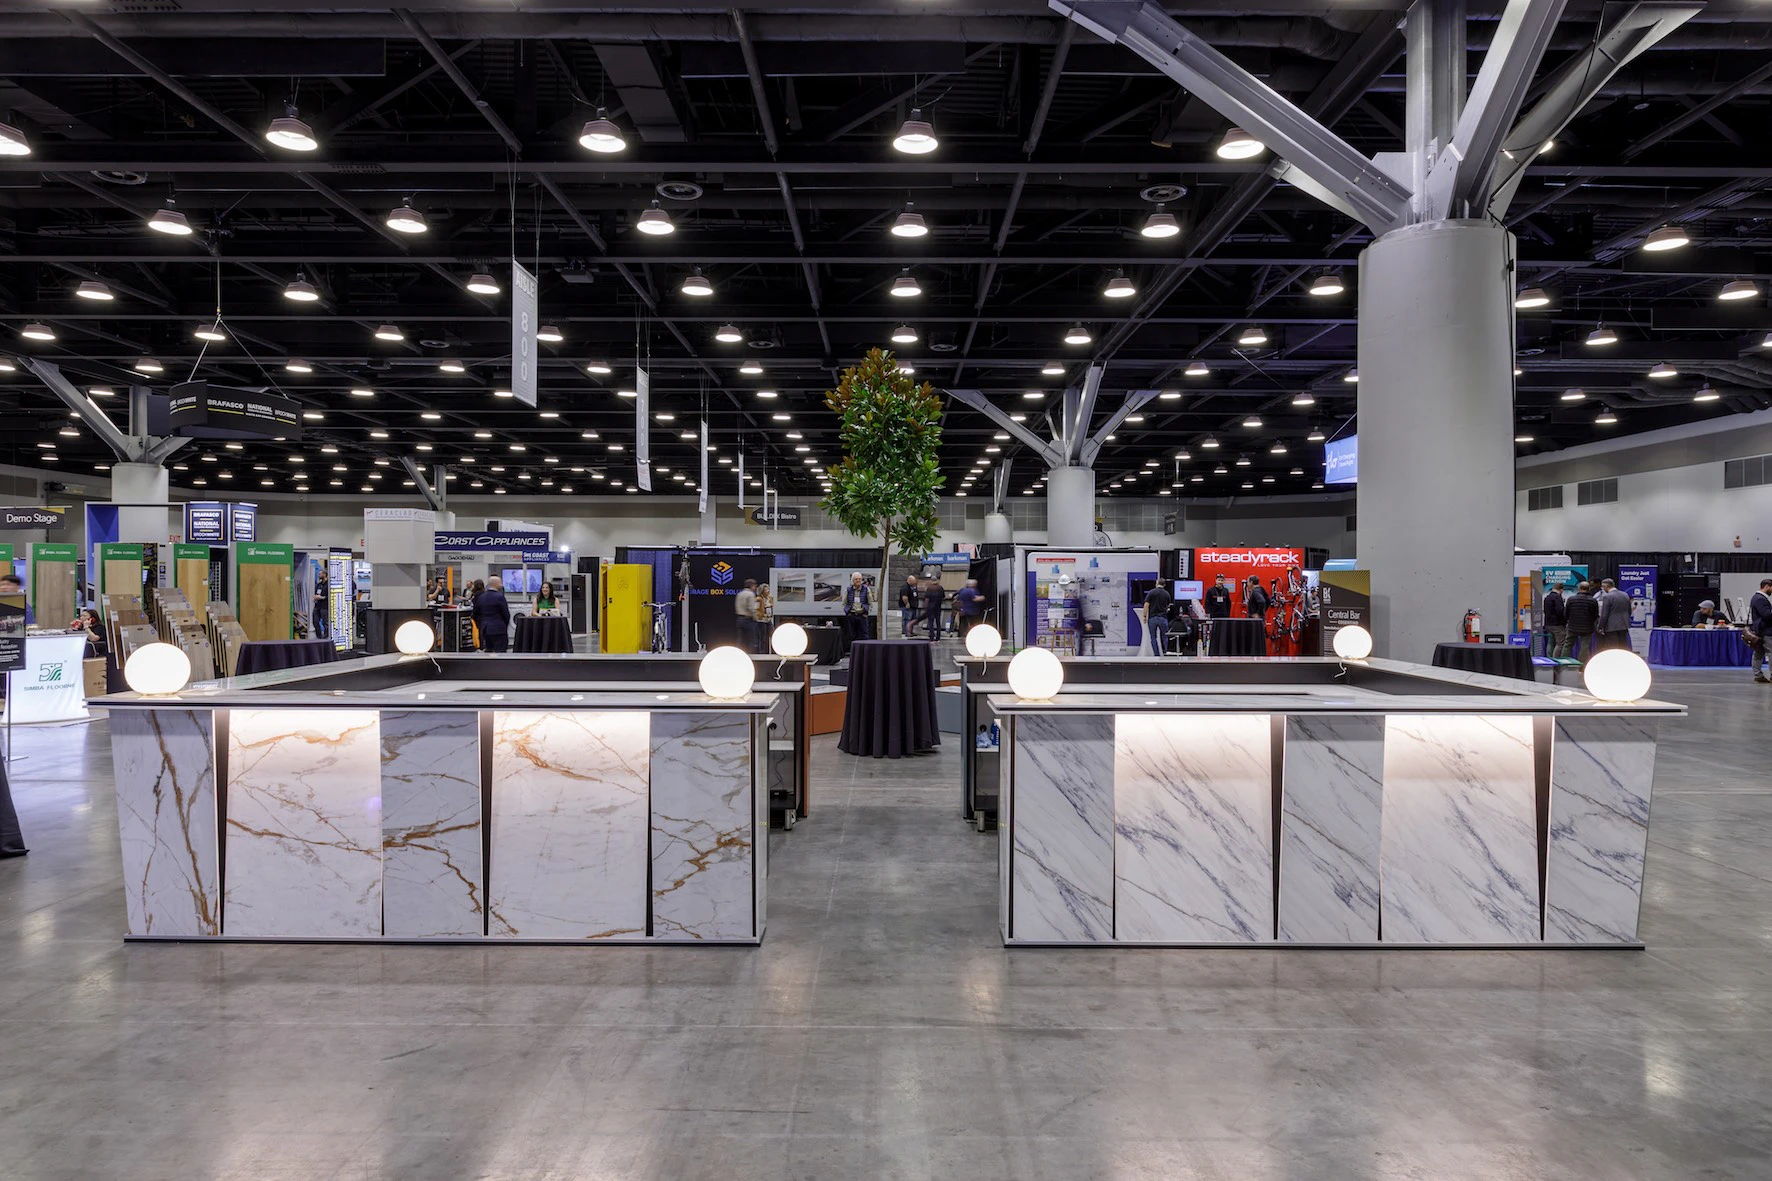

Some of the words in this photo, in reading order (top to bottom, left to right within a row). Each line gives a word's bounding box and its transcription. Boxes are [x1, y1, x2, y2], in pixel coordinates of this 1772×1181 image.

[515, 270, 535, 299] AISLE
[207, 399, 244, 410] BRAFASCO
[247, 403, 273, 412] NATIONAL
[6, 513, 32, 523] Demo
[33, 513, 58, 524] Stage
[434, 535, 475, 546] COAST
[475, 536, 547, 546] APPLIANCES
[1200, 550, 1299, 567] steadyrack
[710, 588, 724, 596] BOX
[1327, 609, 1350, 619] Central
[1349, 610, 1361, 620] Bar
